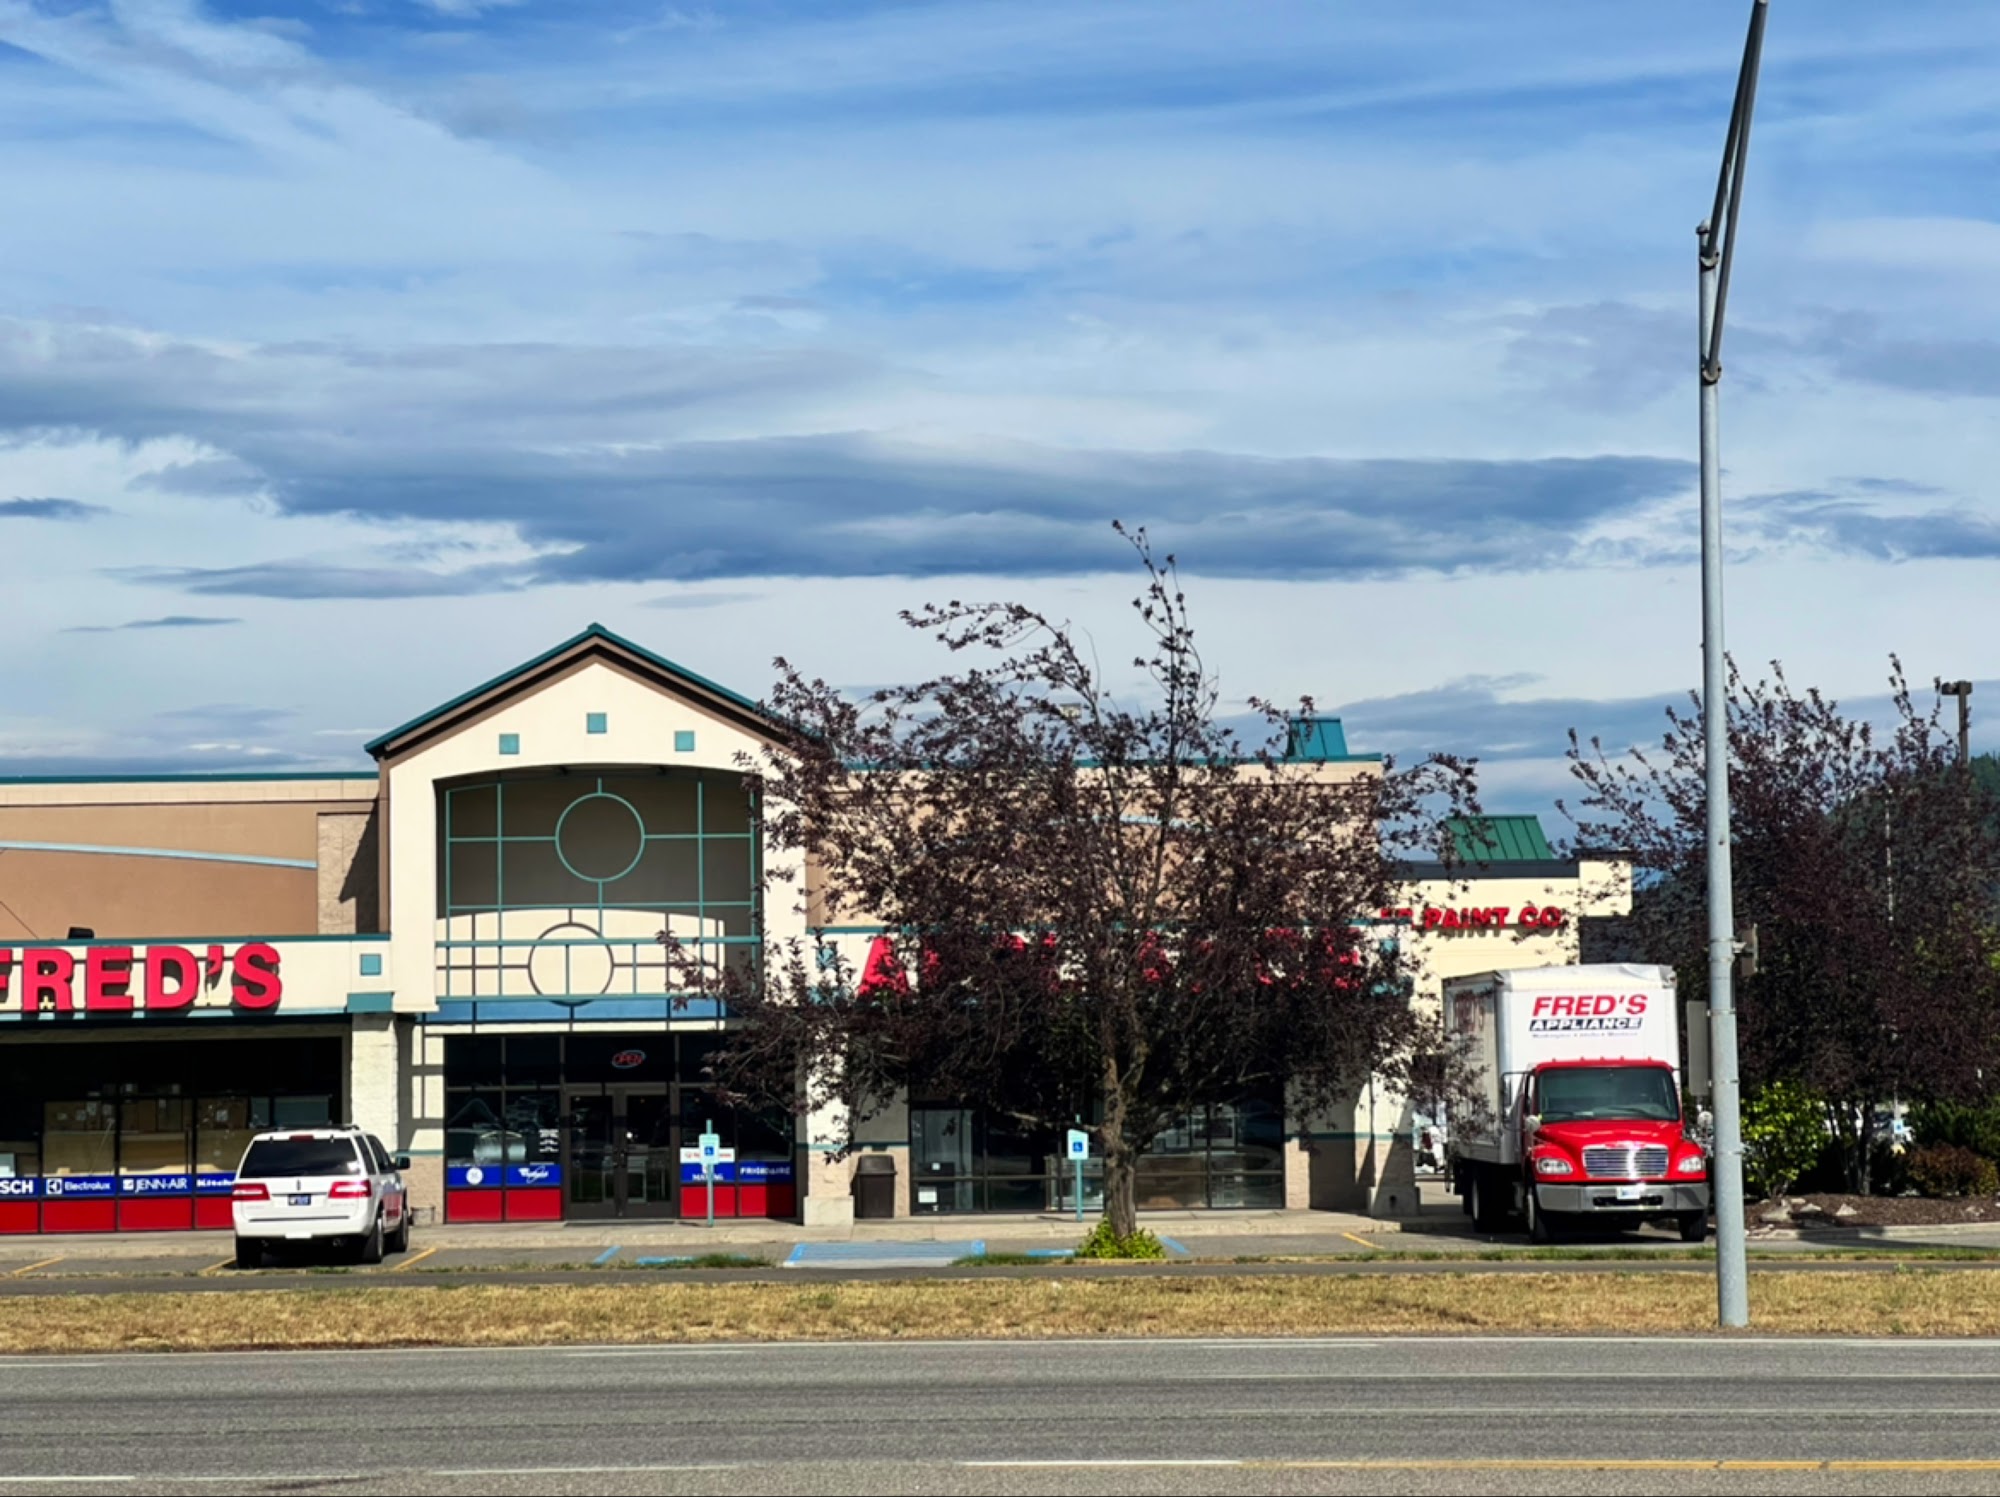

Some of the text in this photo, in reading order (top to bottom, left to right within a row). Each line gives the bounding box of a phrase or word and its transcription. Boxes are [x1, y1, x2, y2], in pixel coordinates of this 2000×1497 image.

[1424, 907, 1510, 930] PAINT
[0, 942, 283, 1012] RED'S
[1532, 994, 1648, 1016] FRED'S
[1530, 1018, 1642, 1031] APPLIANCE
[64, 1181, 111, 1191] Electrolux
[135, 1178, 188, 1194] JENN-AIR
